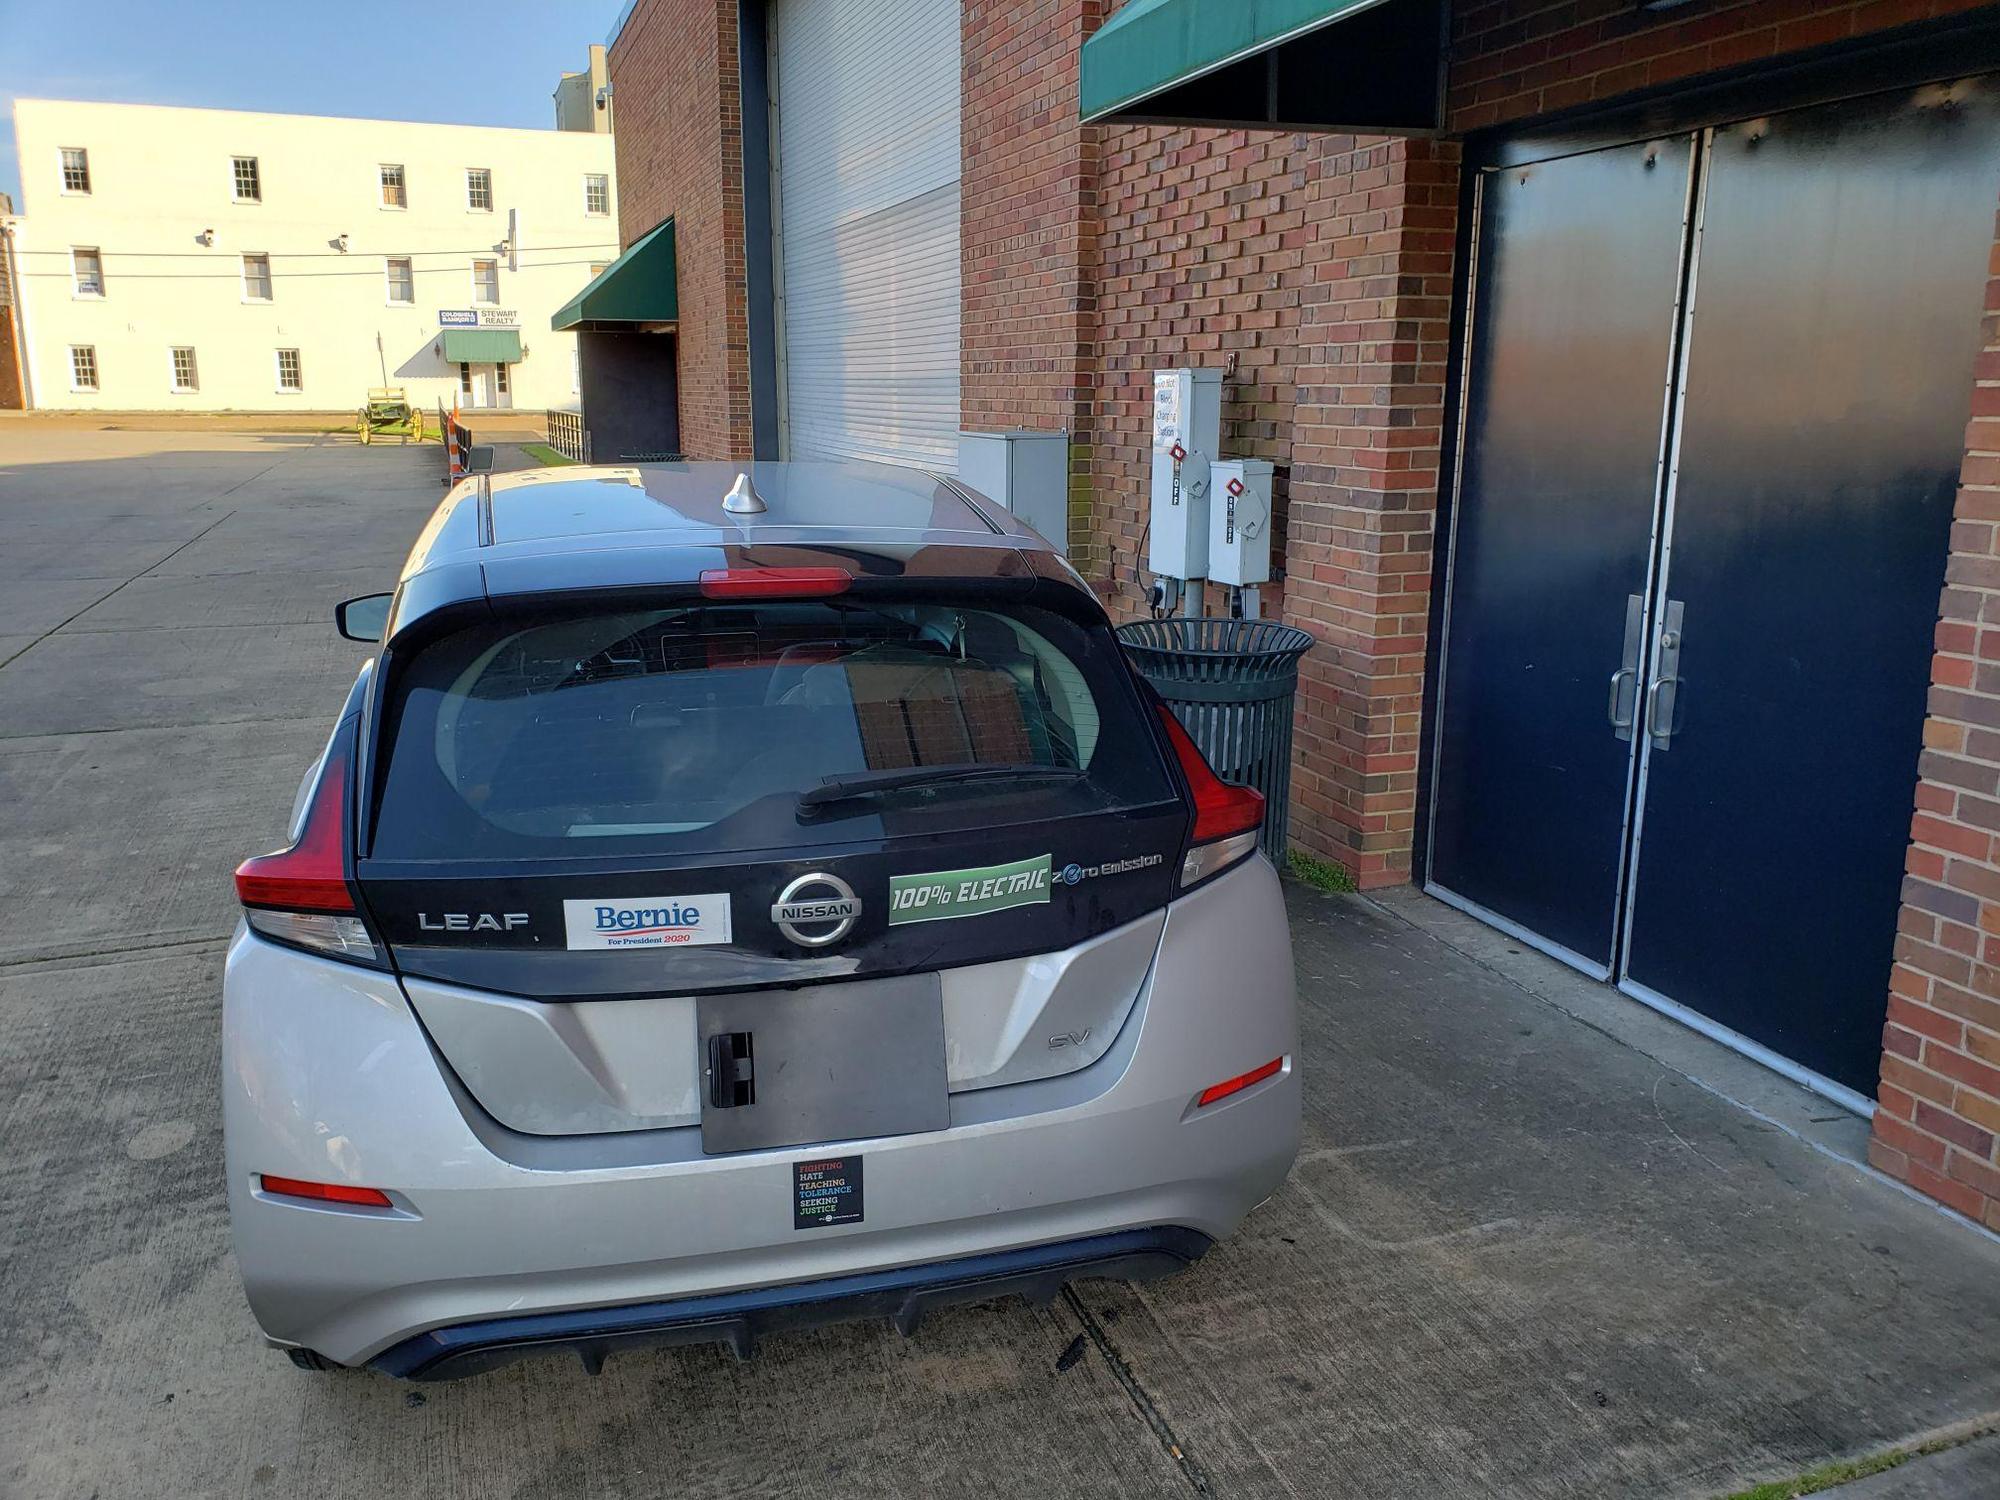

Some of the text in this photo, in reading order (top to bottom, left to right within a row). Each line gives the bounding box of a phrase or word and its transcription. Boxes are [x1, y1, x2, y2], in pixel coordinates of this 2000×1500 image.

[1101, 854, 1162, 875] Emission
[892, 867, 1049, 911] 100% ELECTRIC
[594, 902, 700, 929] Bernie
[781, 903, 853, 919] NISSAN
[418, 912, 529, 931] LEAF
[623, 936, 662, 944] President
[664, 934, 690, 943] 2020
[1048, 1028, 1090, 1050] SV
[800, 1162, 842, 1172] FIGHTING
[800, 1172, 824, 1180] HATE
[799, 1179, 845, 1190] TEACHING
[799, 1186, 852, 1198] TOLERANCE
[800, 1197, 838, 1207] SEEKING
[800, 1205, 837, 1216] JUSTICE
